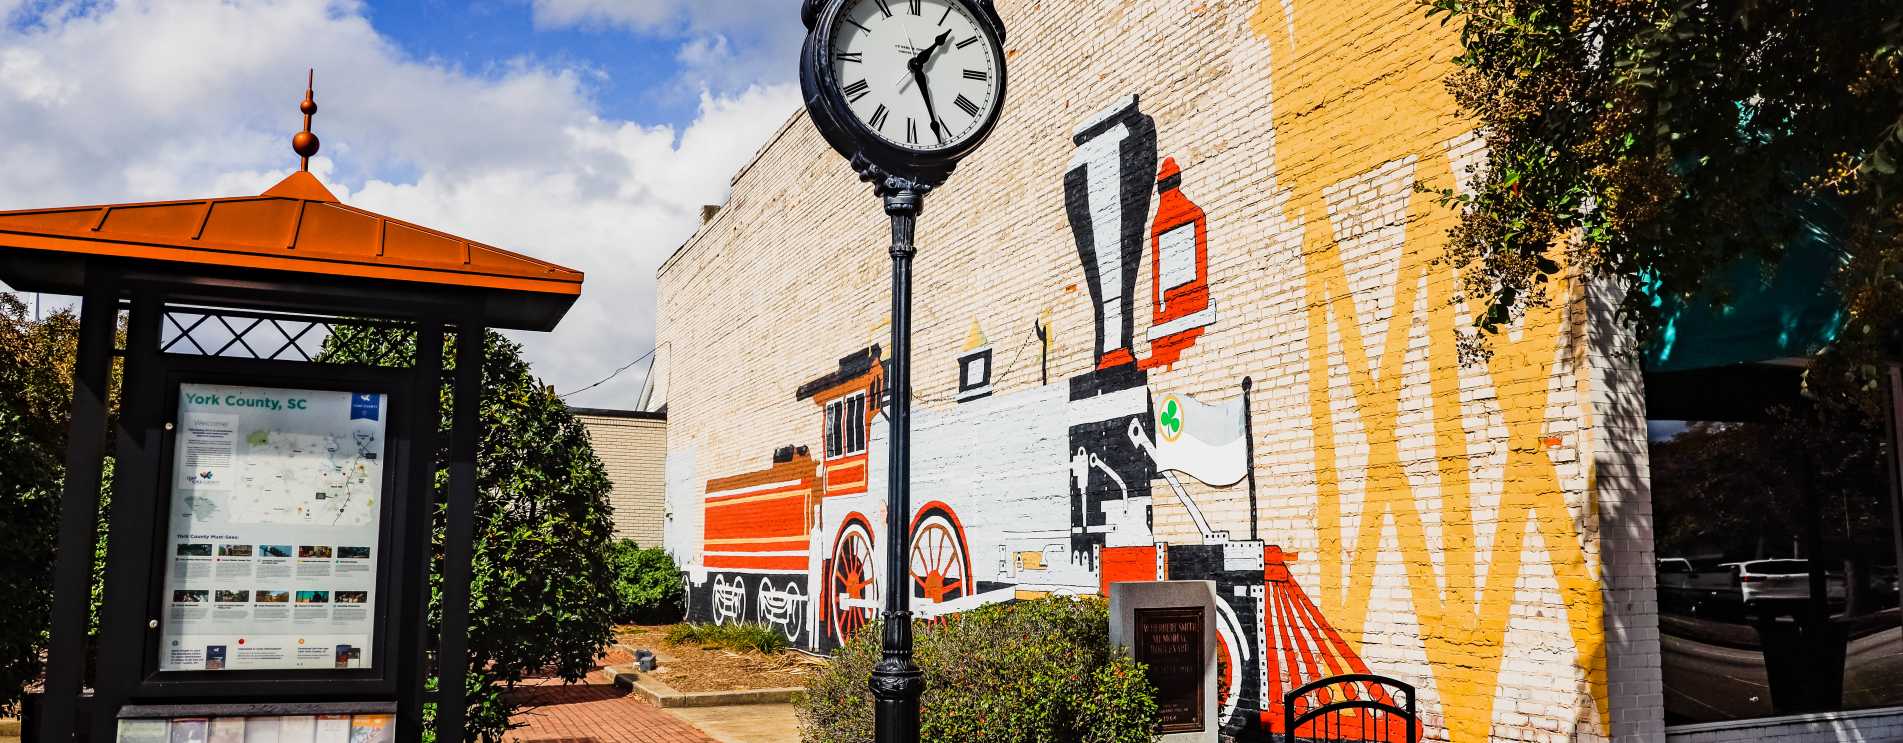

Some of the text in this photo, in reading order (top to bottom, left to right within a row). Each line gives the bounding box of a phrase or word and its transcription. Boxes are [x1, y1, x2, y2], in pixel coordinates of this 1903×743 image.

[955, 35, 979, 50] II
[962, 68, 988, 81] III
[843, 78, 871, 104] VIII
[868, 103, 890, 132] VII
[906, 117, 919, 145] VI
[185, 392, 308, 411] York County, SC
